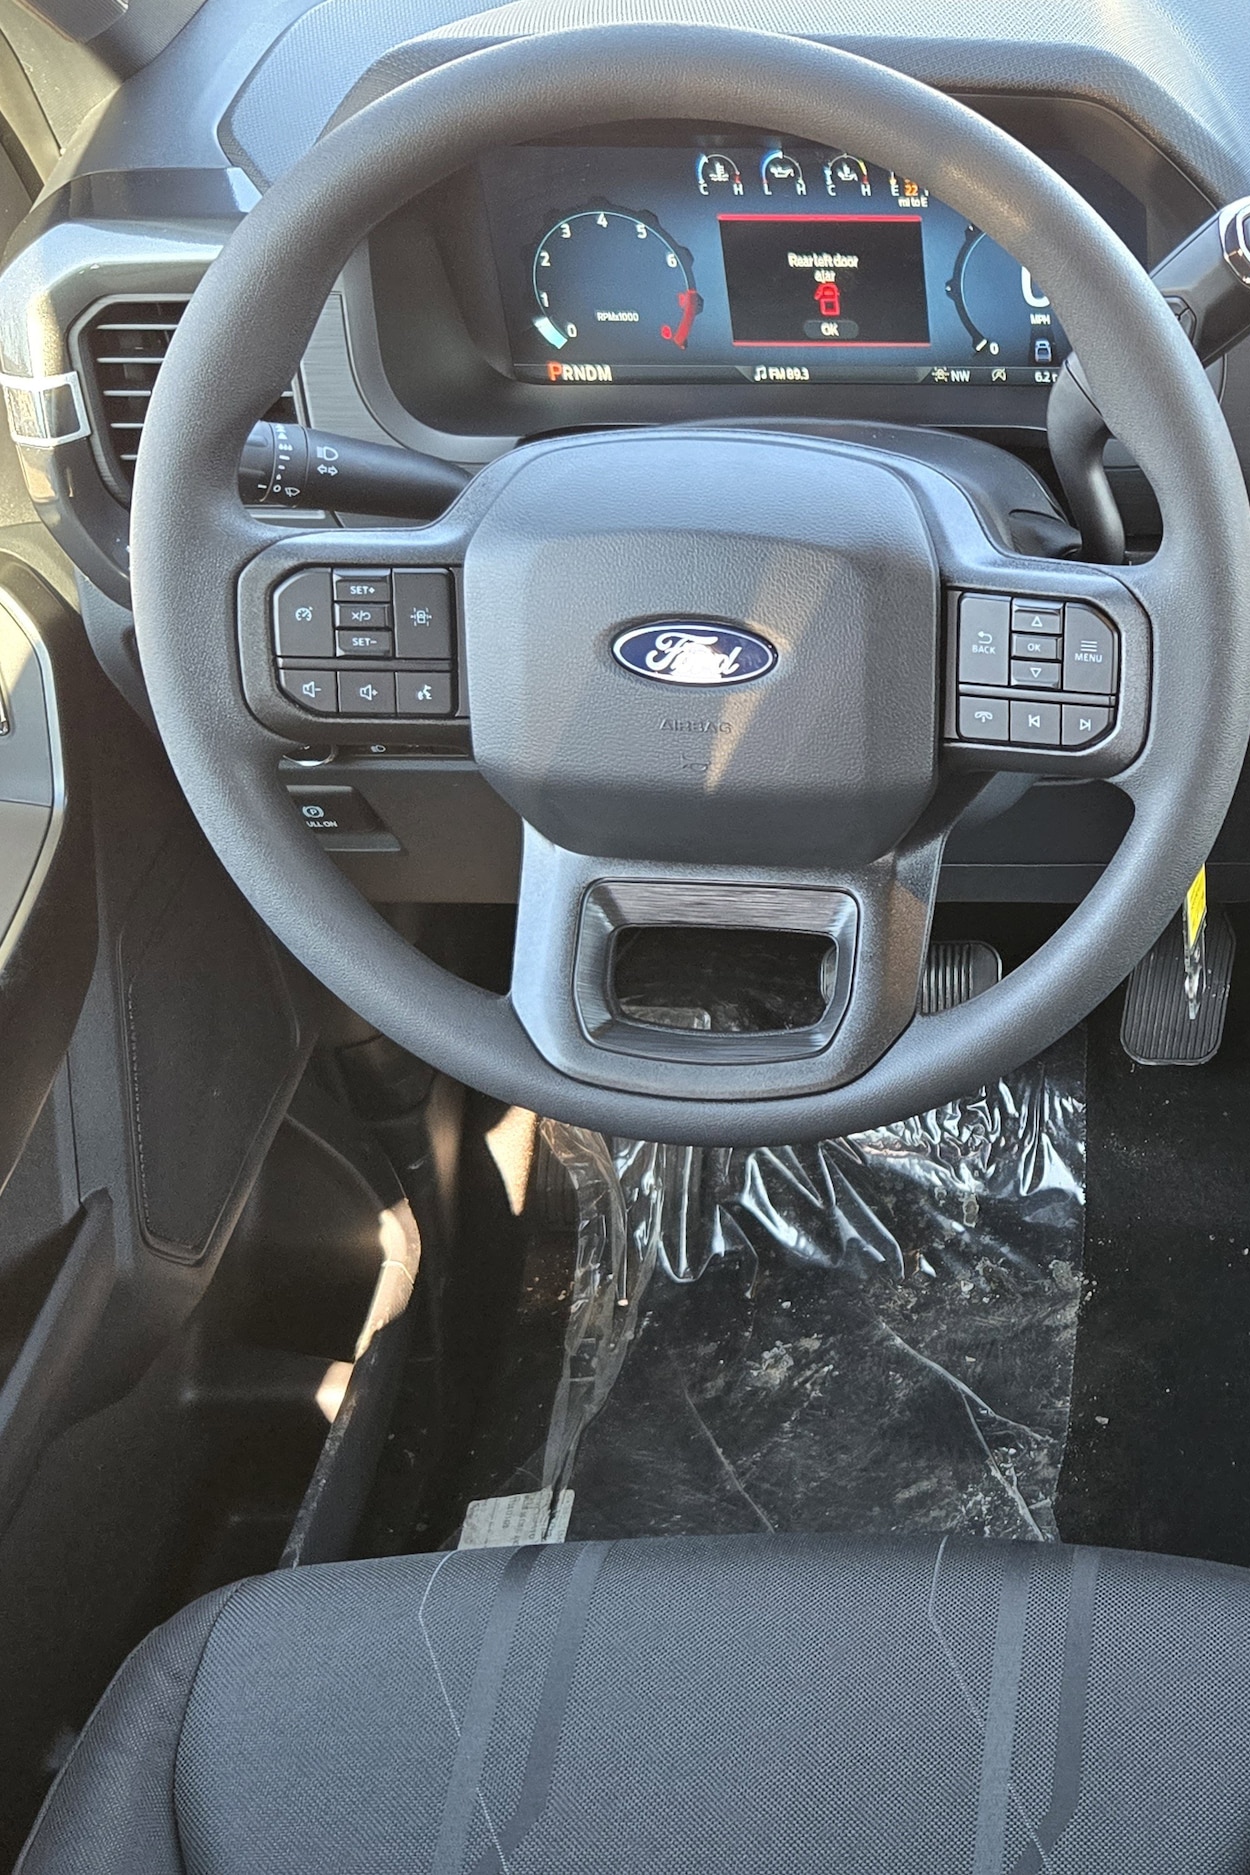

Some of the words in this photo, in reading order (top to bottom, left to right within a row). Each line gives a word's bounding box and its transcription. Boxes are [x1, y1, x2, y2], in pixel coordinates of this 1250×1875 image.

[699, 184, 708, 196] C
[733, 184, 744, 195] H
[764, 184, 772, 195] L
[797, 183, 807, 195] H
[826, 184, 836, 196] C
[861, 184, 872, 195] H
[890, 184, 900, 196] E
[904, 183, 918, 196] 22
[596, 213, 608, 228] 4
[560, 223, 571, 239] 3
[635, 223, 647, 239] 5
[540, 252, 551, 266] 2
[666, 253, 677, 267] 6
[787, 252, 813, 268] Rear
[812, 252, 834, 268] left
[833, 252, 859, 268] door
[541, 292, 549, 307] 1
[567, 324, 578, 337] 0
[820, 322, 840, 337] OK
[990, 343, 1000, 355] 0
[768, 366, 786, 380] FM
[786, 366, 810, 380] 89.3
[950, 370, 971, 382] NW
[645, 631, 742, 675] Fd
[972, 645, 996, 655] BACK
[1027, 643, 1041, 652] OK
[1075, 653, 1103, 663] MENU
[659, 719, 732, 734] AIRBAG
